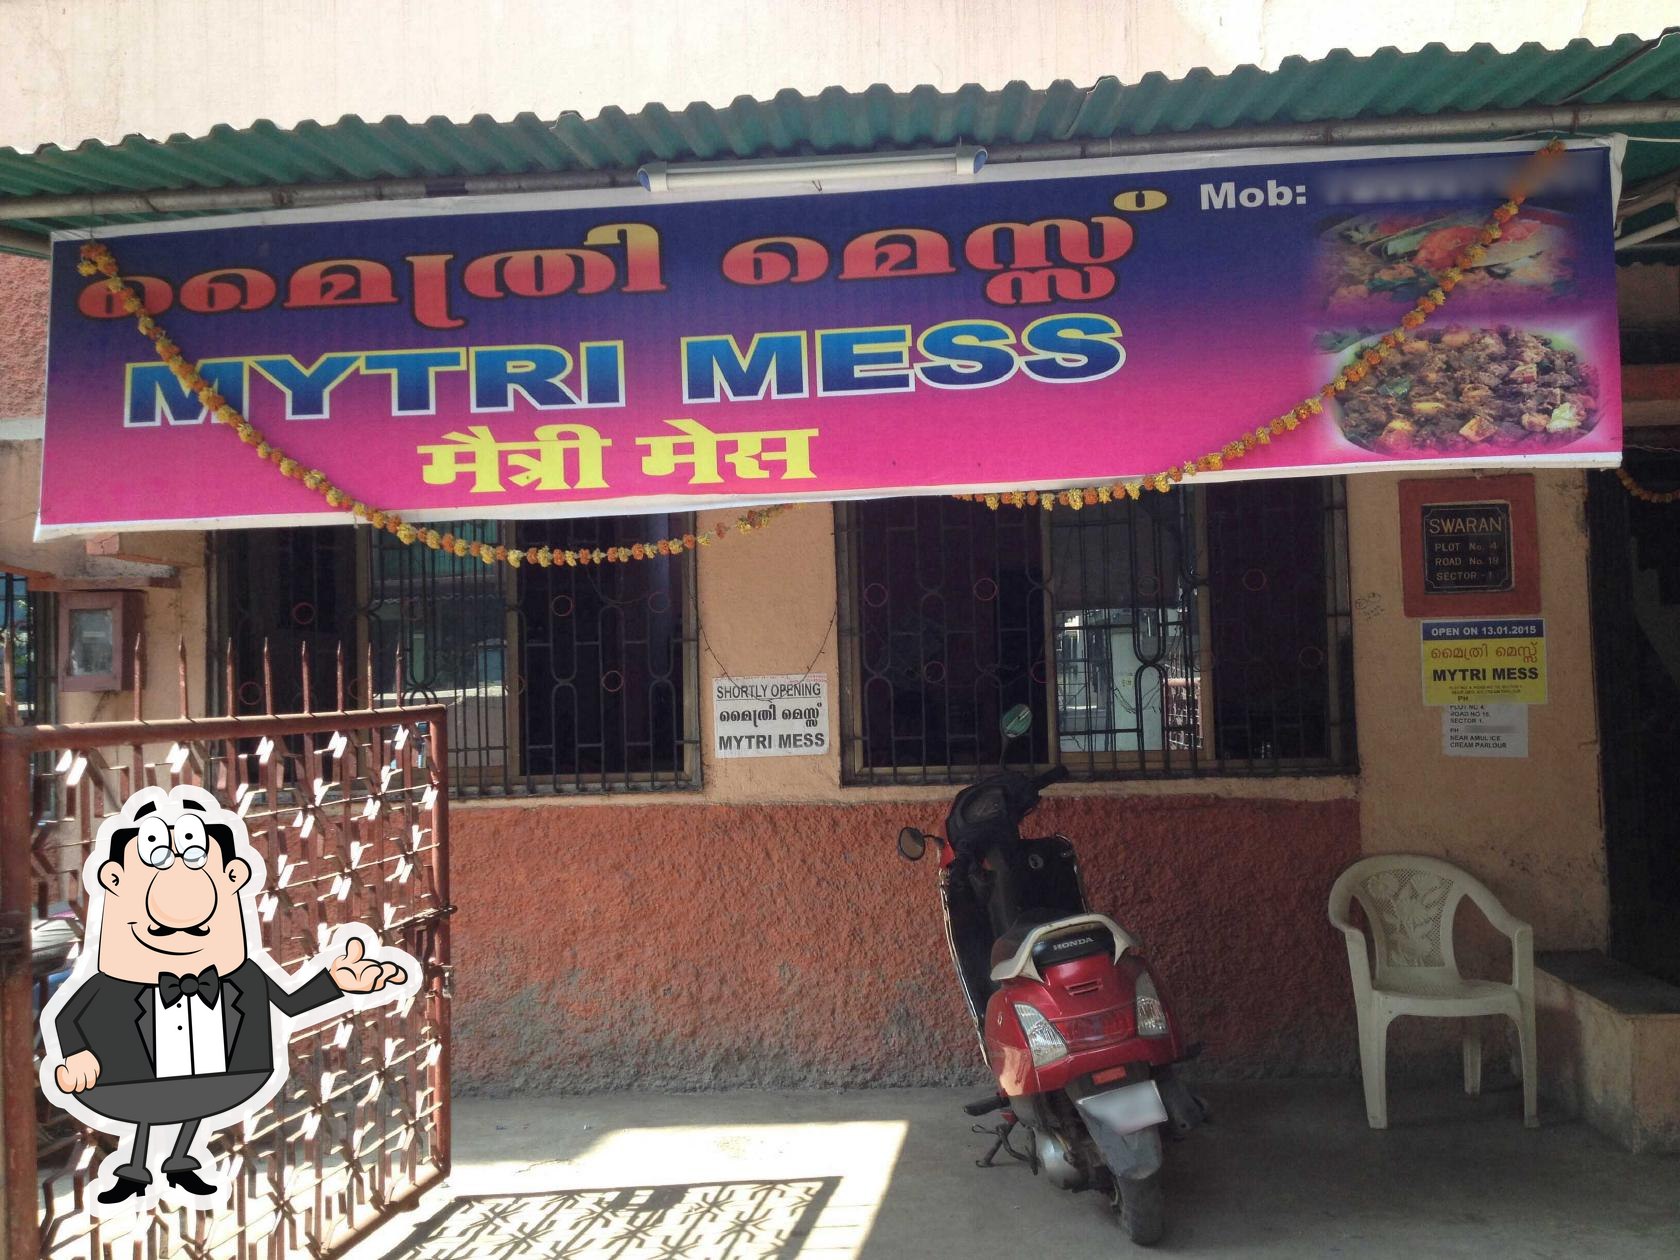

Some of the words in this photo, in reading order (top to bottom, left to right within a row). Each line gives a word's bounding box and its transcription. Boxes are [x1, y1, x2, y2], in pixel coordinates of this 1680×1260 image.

[1199, 180, 1307, 211] Mob:
[123, 340, 626, 429] MYTRI
[680, 313, 1127, 405] MESS
[417, 424, 612, 493] मैत्री
[636, 418, 819, 485] मेस
[1429, 516, 1503, 534] SWARAN
[1435, 542, 1461, 552] PLOT
[1435, 557, 1462, 566] ROAD
[1436, 571, 1477, 581] SECTOR
[1431, 627, 1460, 637] OPEN
[1463, 626, 1478, 636] ON
[1482, 625, 1537, 636] 13.01.2015
[1432, 668, 1486, 682] MYTRI
[1492, 667, 1539, 681] MESS
[717, 685, 768, 699] SHORTLY
[770, 683, 821, 698] OPENING
[719, 735, 772, 750] MYTRI
[778, 732, 825, 749] MESS
[1052, 937, 1095, 951] HONDA
